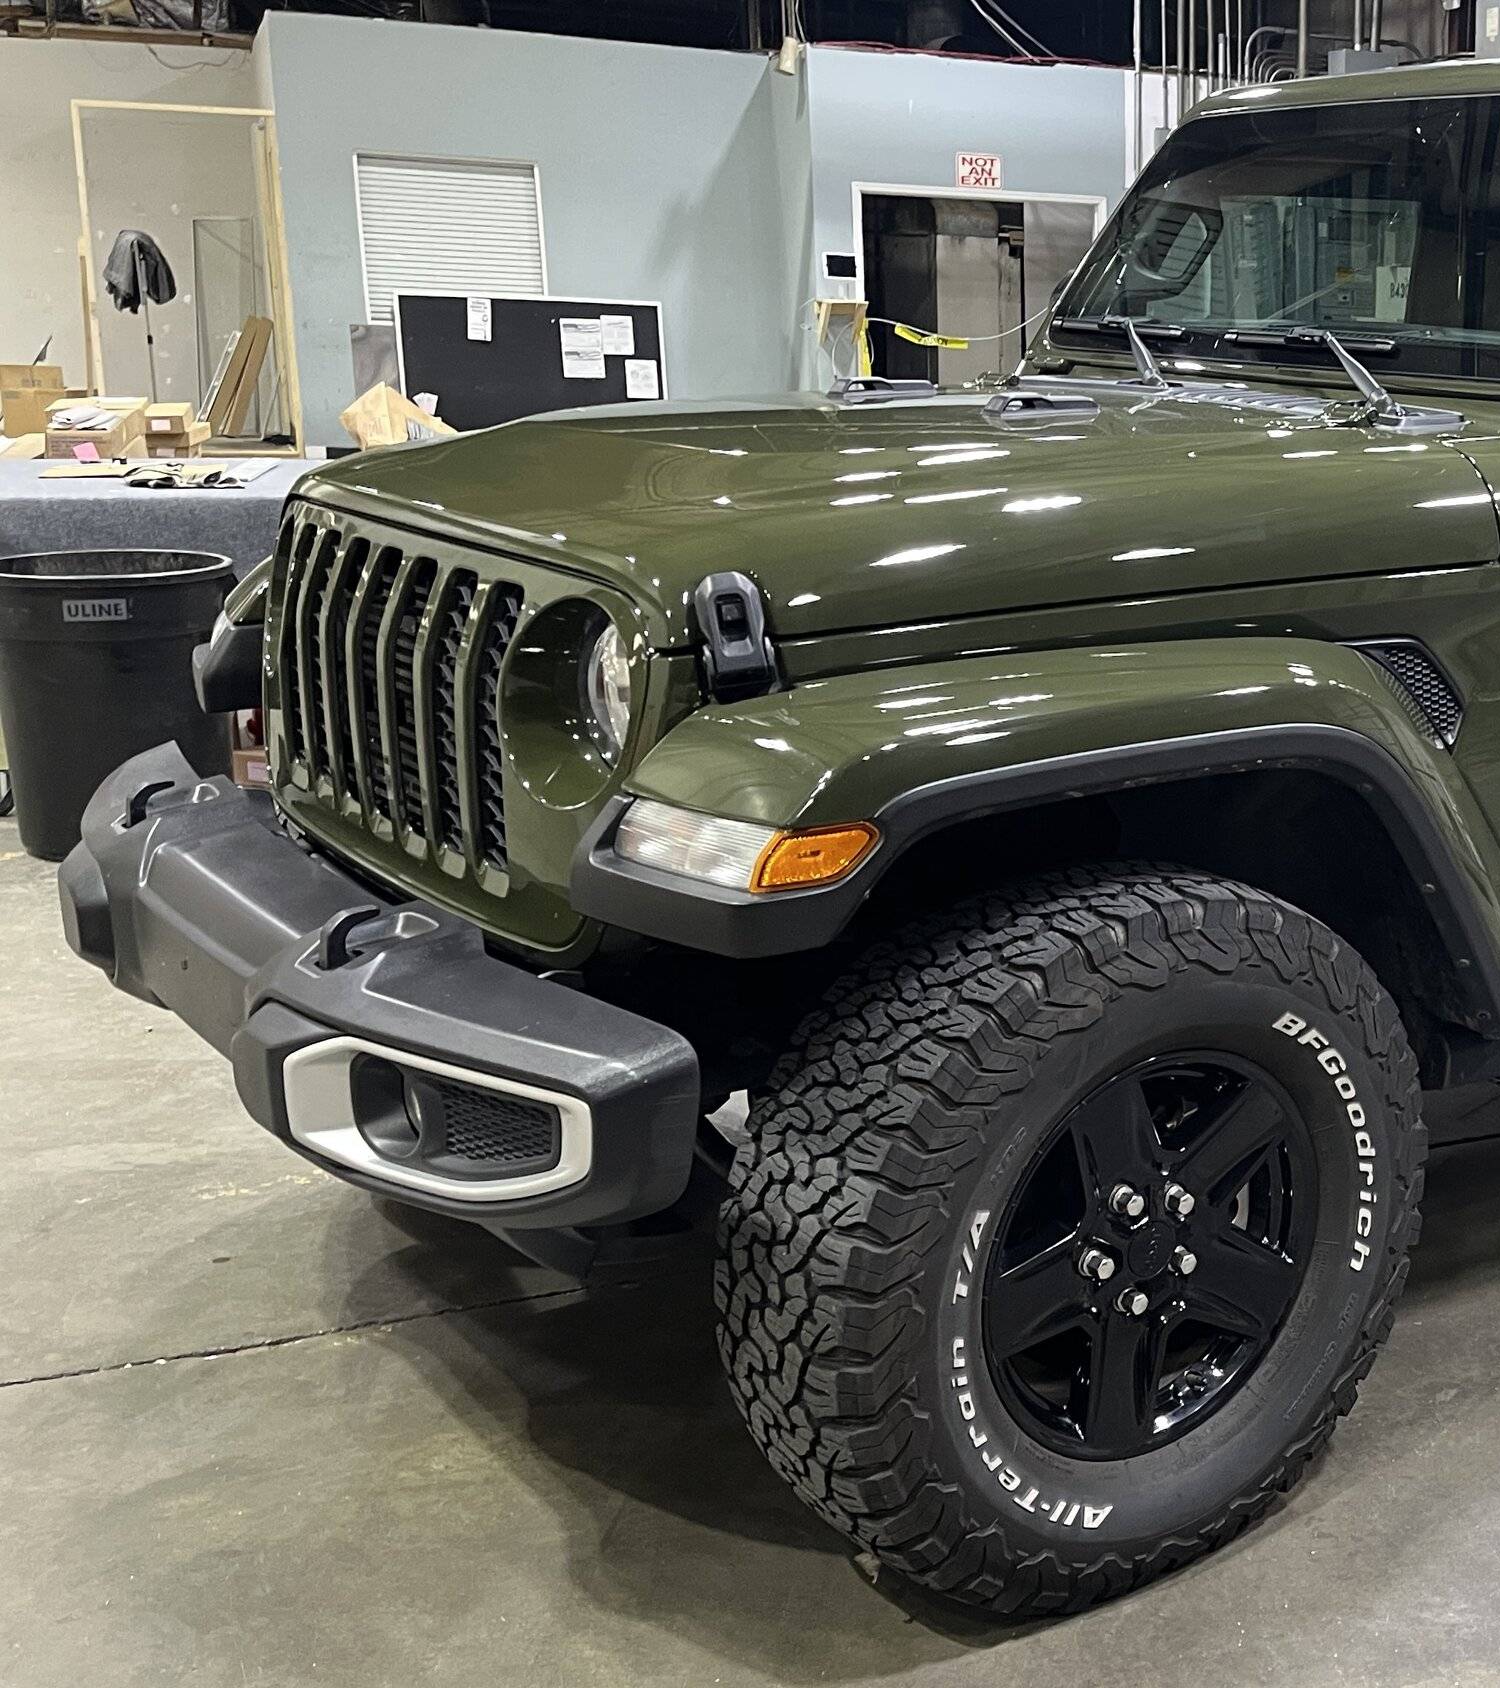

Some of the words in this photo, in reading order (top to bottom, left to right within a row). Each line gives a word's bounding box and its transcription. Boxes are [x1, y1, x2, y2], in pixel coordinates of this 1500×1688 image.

[961, 156, 997, 167] NOT
[969, 167, 992, 177] AN
[961, 176, 999, 187] EXIT
[67, 603, 123, 618] ULINE
[1272, 1011, 1377, 1273] BFGoodrich
[952, 1209, 990, 1305] T/A
[951, 1337, 1114, 1529] All-Terrain
